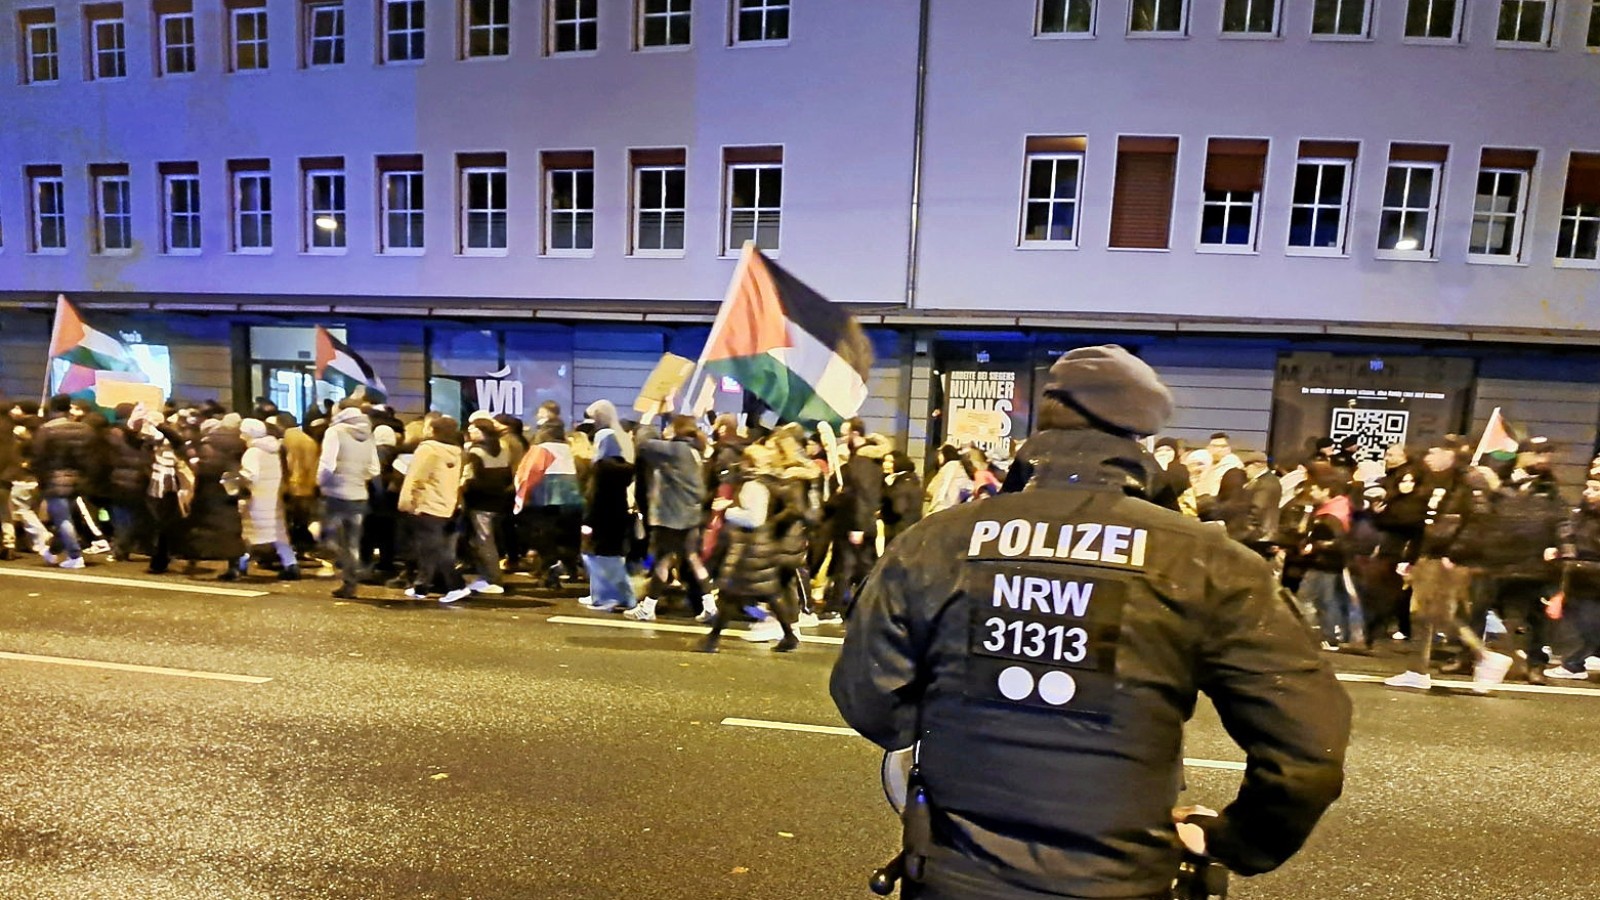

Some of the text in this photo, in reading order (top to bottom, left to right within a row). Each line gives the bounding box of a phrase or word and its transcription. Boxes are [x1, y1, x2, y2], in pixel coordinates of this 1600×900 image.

[950, 380, 1015, 399] NUMMER
[968, 519, 1148, 566] POLIZEI
[992, 573, 1094, 617] NRW
[983, 617, 1089, 663] 31313
